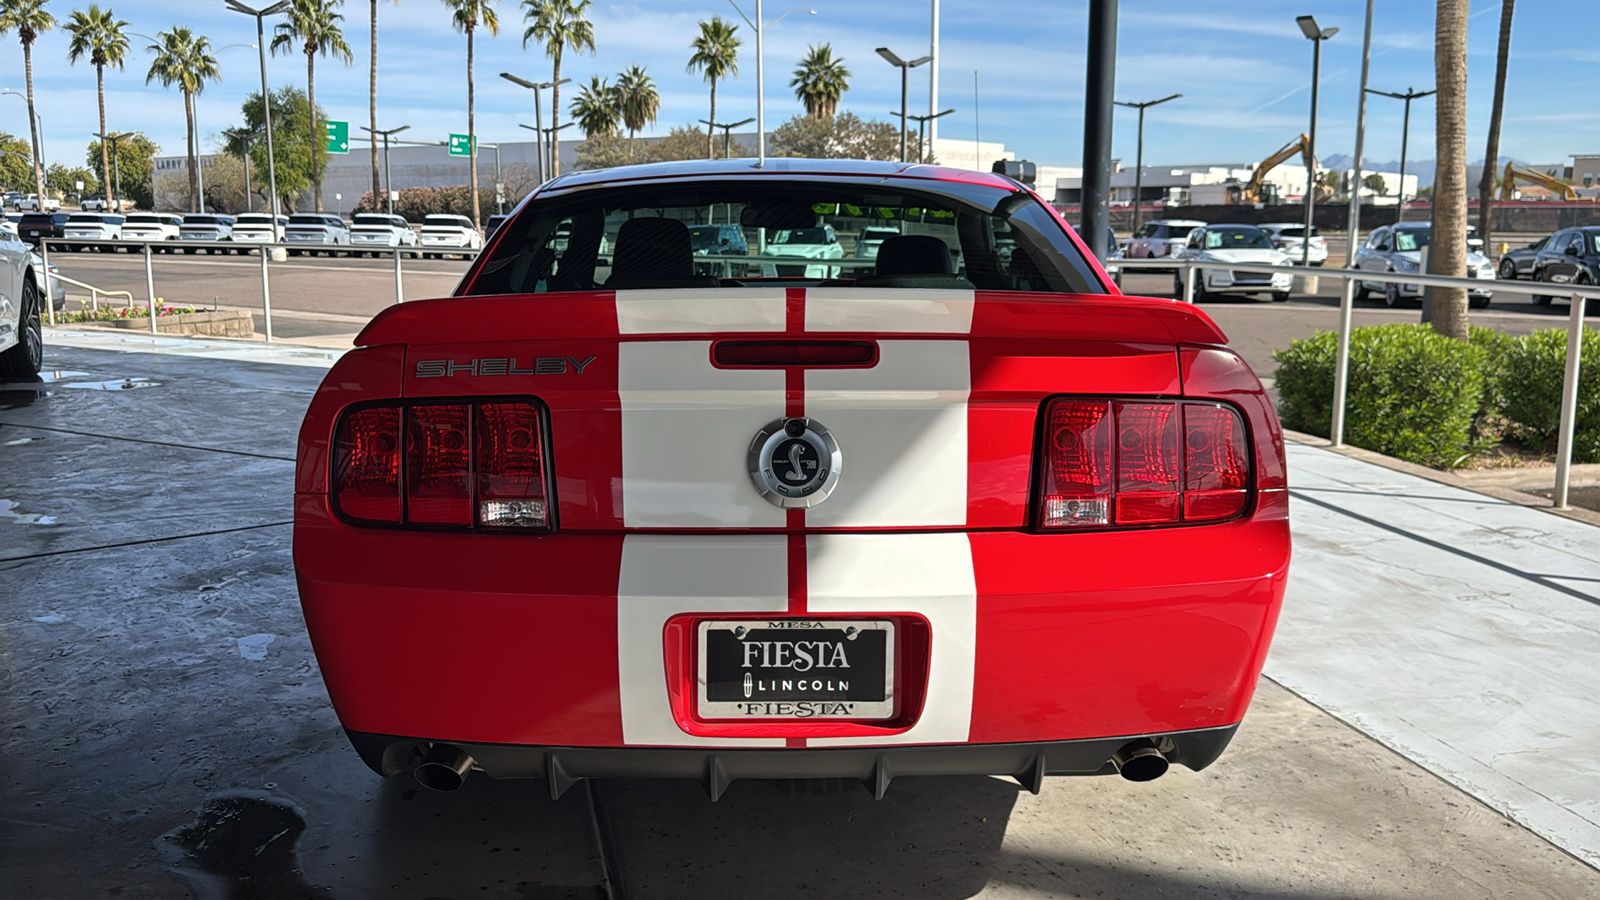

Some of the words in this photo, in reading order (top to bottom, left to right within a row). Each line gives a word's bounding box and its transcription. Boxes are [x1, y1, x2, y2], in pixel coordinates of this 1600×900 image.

[156, 160, 182, 170] LARRY
[416, 356, 597, 378] SHELBY
[741, 641, 851, 672] FIESTA
[758, 680, 849, 691] LINCOLN
[744, 702, 852, 717] FIESTA
